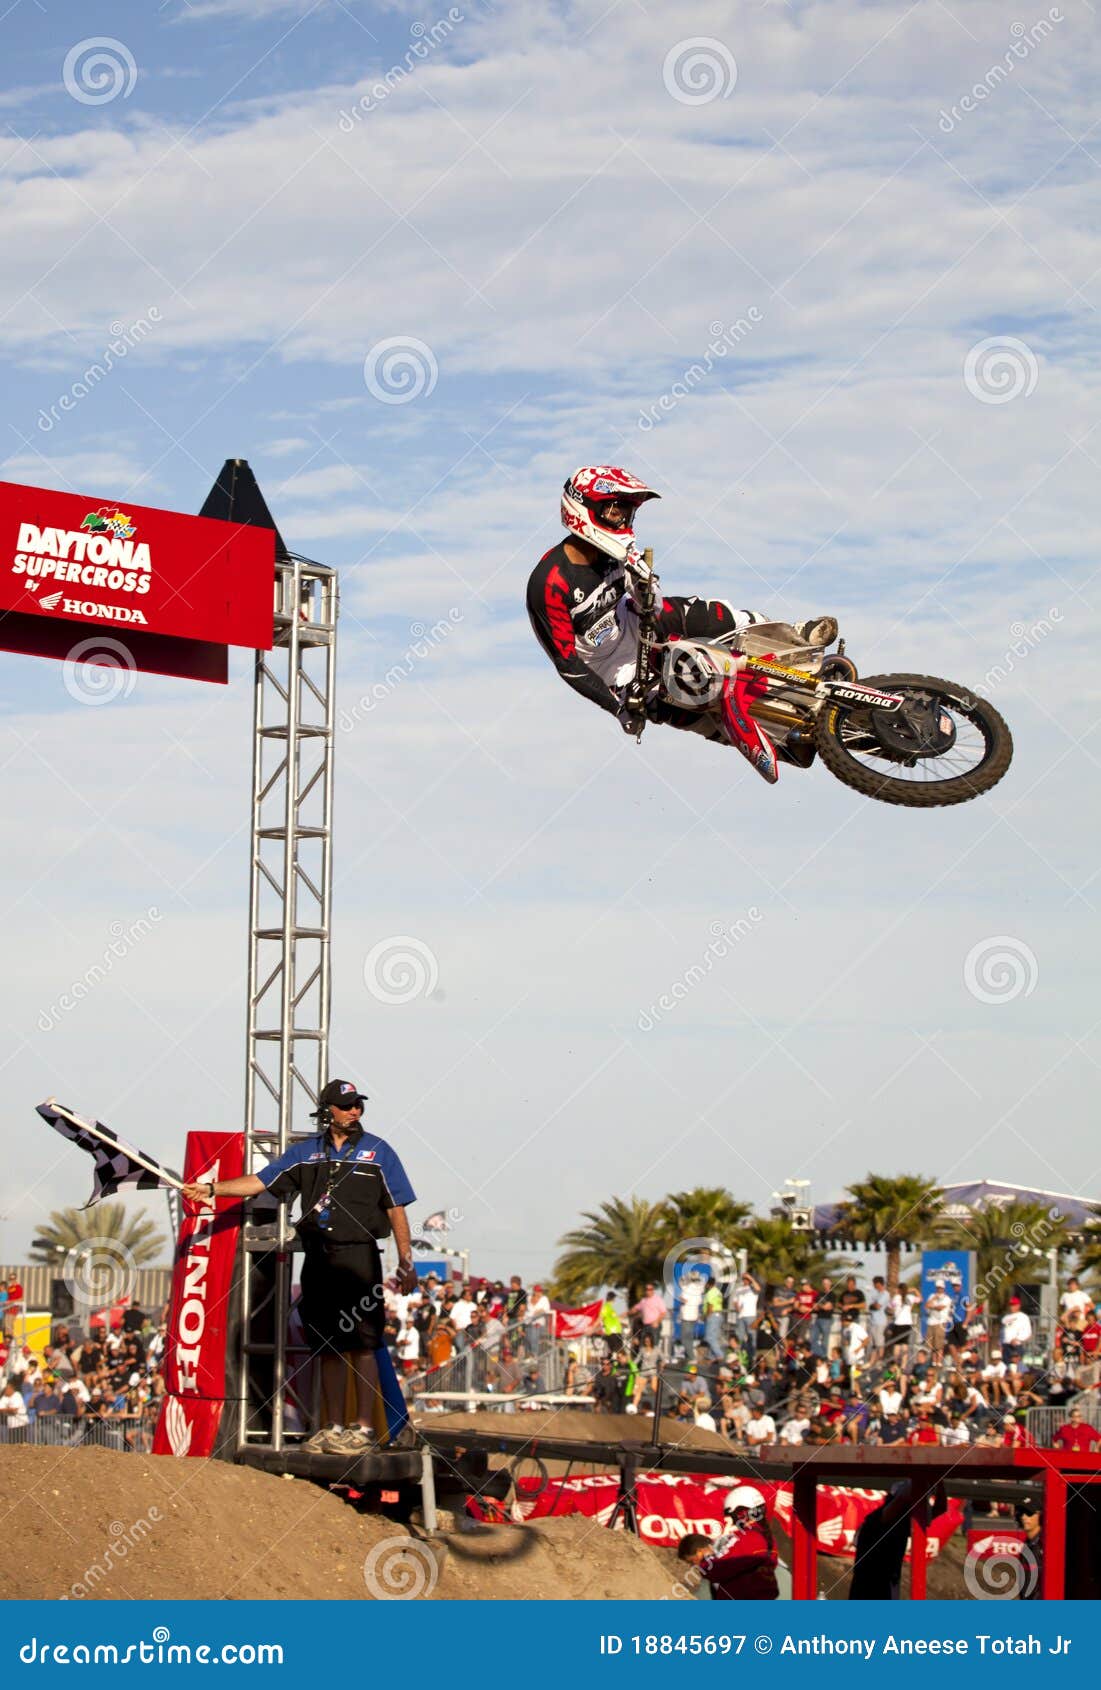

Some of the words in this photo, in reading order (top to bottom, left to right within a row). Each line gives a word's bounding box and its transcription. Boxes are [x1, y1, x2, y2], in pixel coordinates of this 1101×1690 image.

[16, 523, 152, 572] DAYTONA
[12, 554, 152, 594] SUPERCROSS
[24, 579, 40, 592] By
[62, 597, 148, 625] HONDA
[834, 688, 893, 708] DUNLOP
